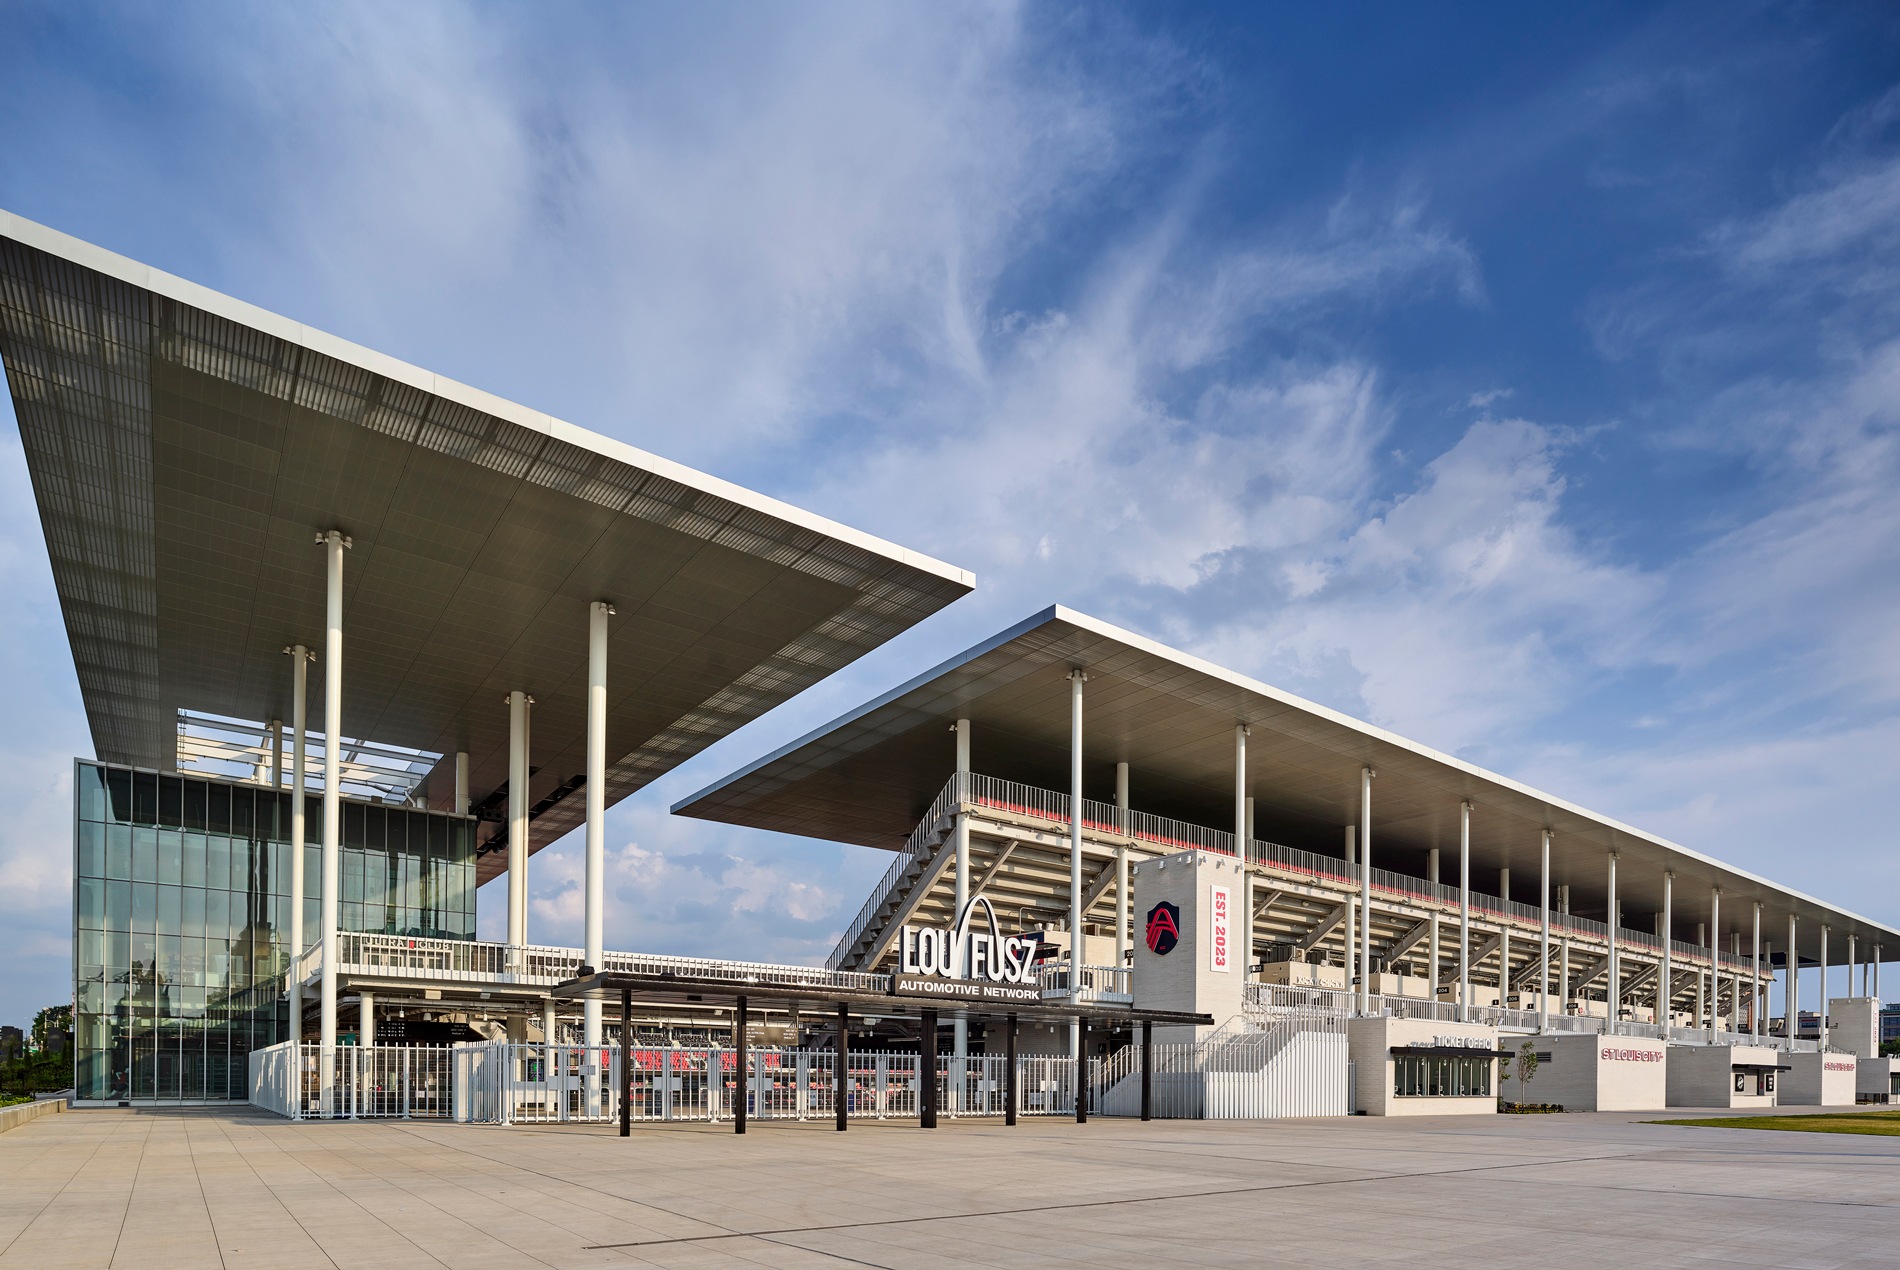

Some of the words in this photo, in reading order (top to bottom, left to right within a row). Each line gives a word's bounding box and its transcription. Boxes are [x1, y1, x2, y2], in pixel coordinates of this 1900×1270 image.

[1216, 892, 1226, 922] EST.
[419, 941, 449, 949] CLUB
[1216, 926, 1226, 967] 2023
[902, 925, 961, 979] LOU
[971, 933, 1036, 983] FUSZ
[899, 980, 980, 996] AUTOMOTIVE
[983, 986, 1040, 1000] NETWORK
[1436, 1035, 1466, 1047] TICKET
[1421, 1058, 1425, 1066] 2
[1602, 1048, 1615, 1060] ST
[1616, 1049, 1641, 1061] LOUIS
[1642, 1051, 1662, 1062] CITY
[1443, 1059, 1447, 1067] 3
